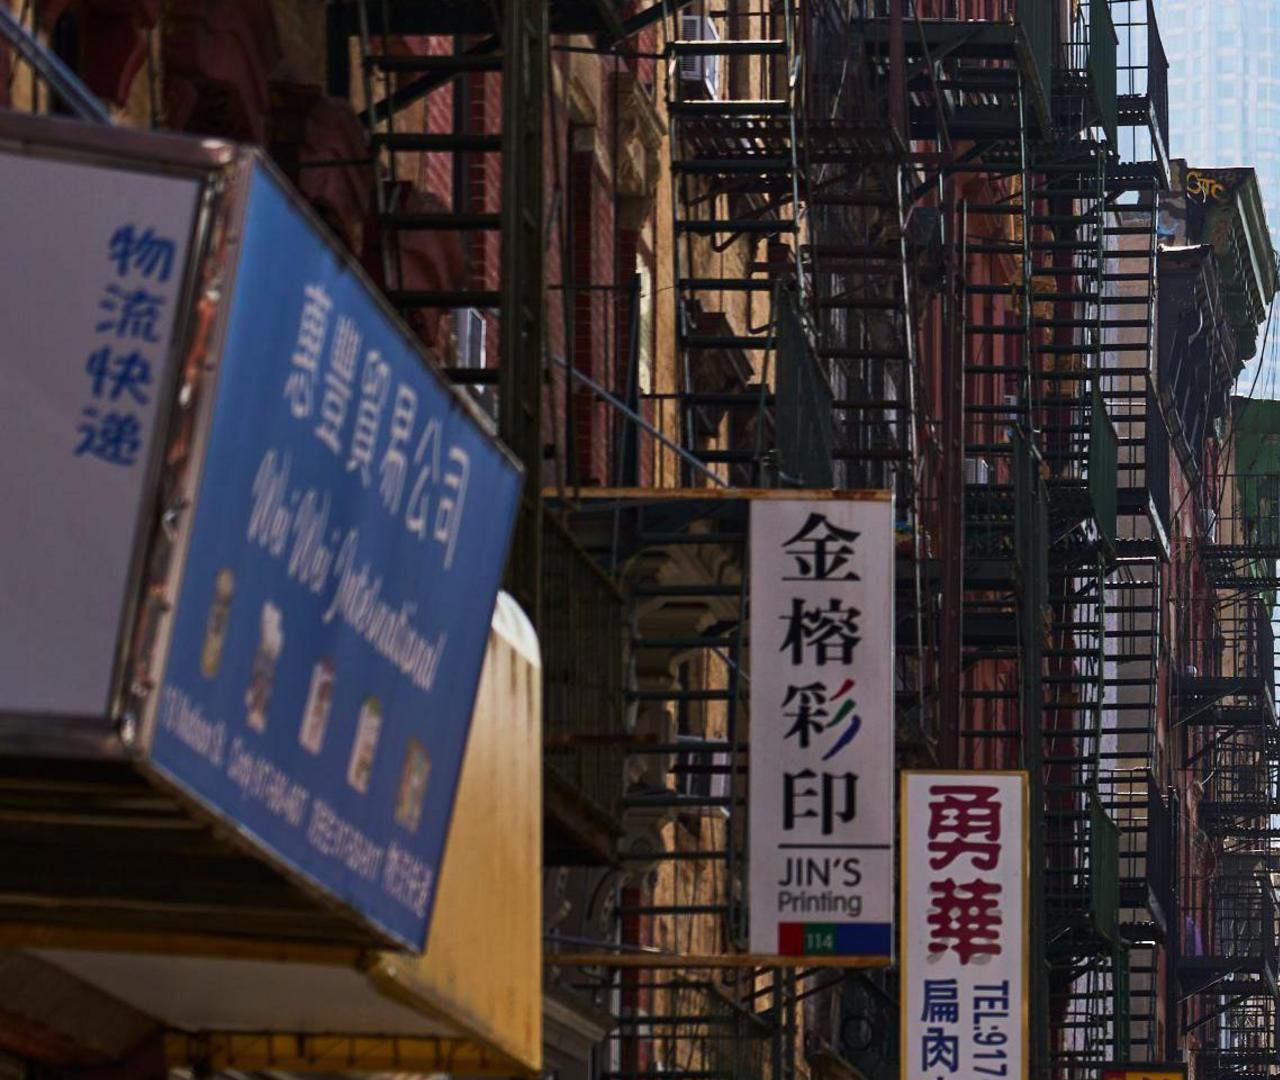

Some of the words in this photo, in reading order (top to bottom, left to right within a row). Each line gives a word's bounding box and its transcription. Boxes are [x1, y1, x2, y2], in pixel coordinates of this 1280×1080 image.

[779, 511, 863, 836] 金榕彩印
[778, 857, 862, 888] JIN'S
[927, 784, 1003, 965] 勇華
[778, 891, 862, 917] Printing
[806, 932, 833, 949] 114
